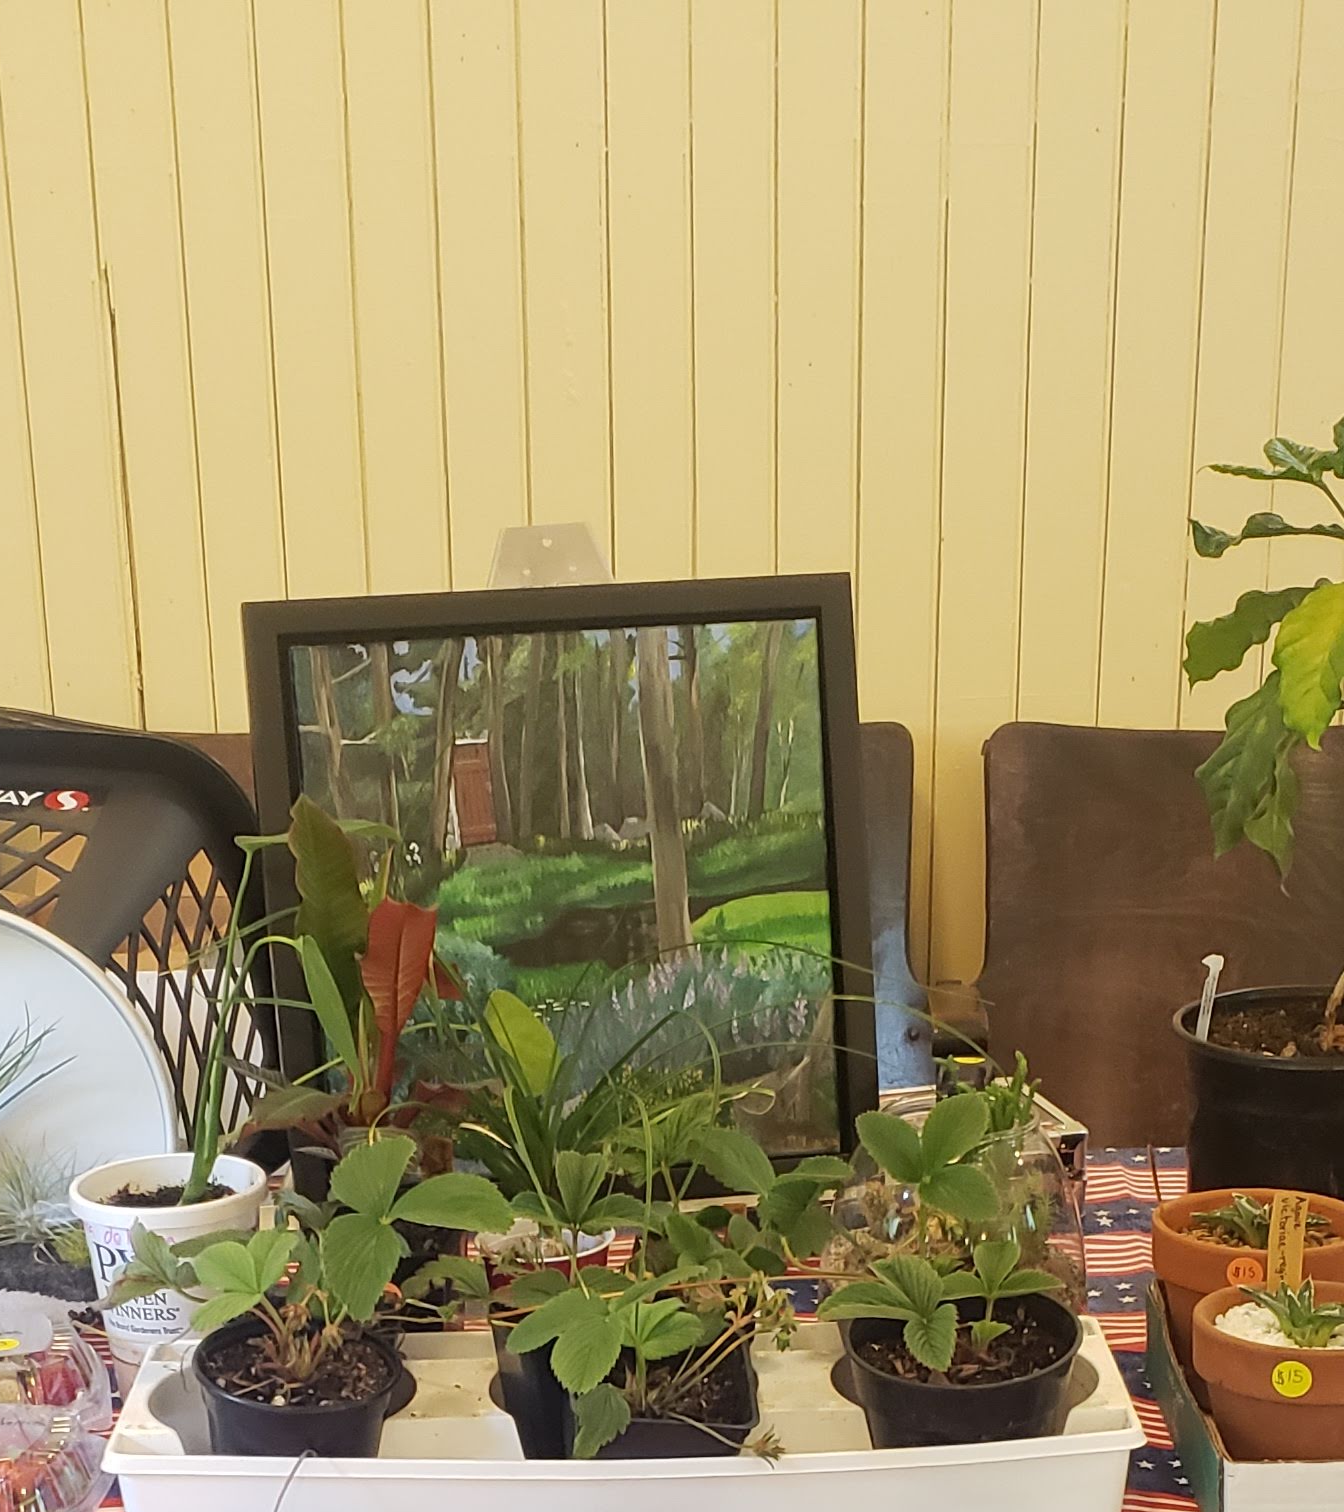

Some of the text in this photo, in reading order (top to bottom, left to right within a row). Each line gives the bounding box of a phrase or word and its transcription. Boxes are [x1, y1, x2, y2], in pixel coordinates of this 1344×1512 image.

[1232, 1266, 1257, 1279] $15
[111, 1303, 178, 1322] INNERS
[1275, 1367, 1305, 1386] $15
